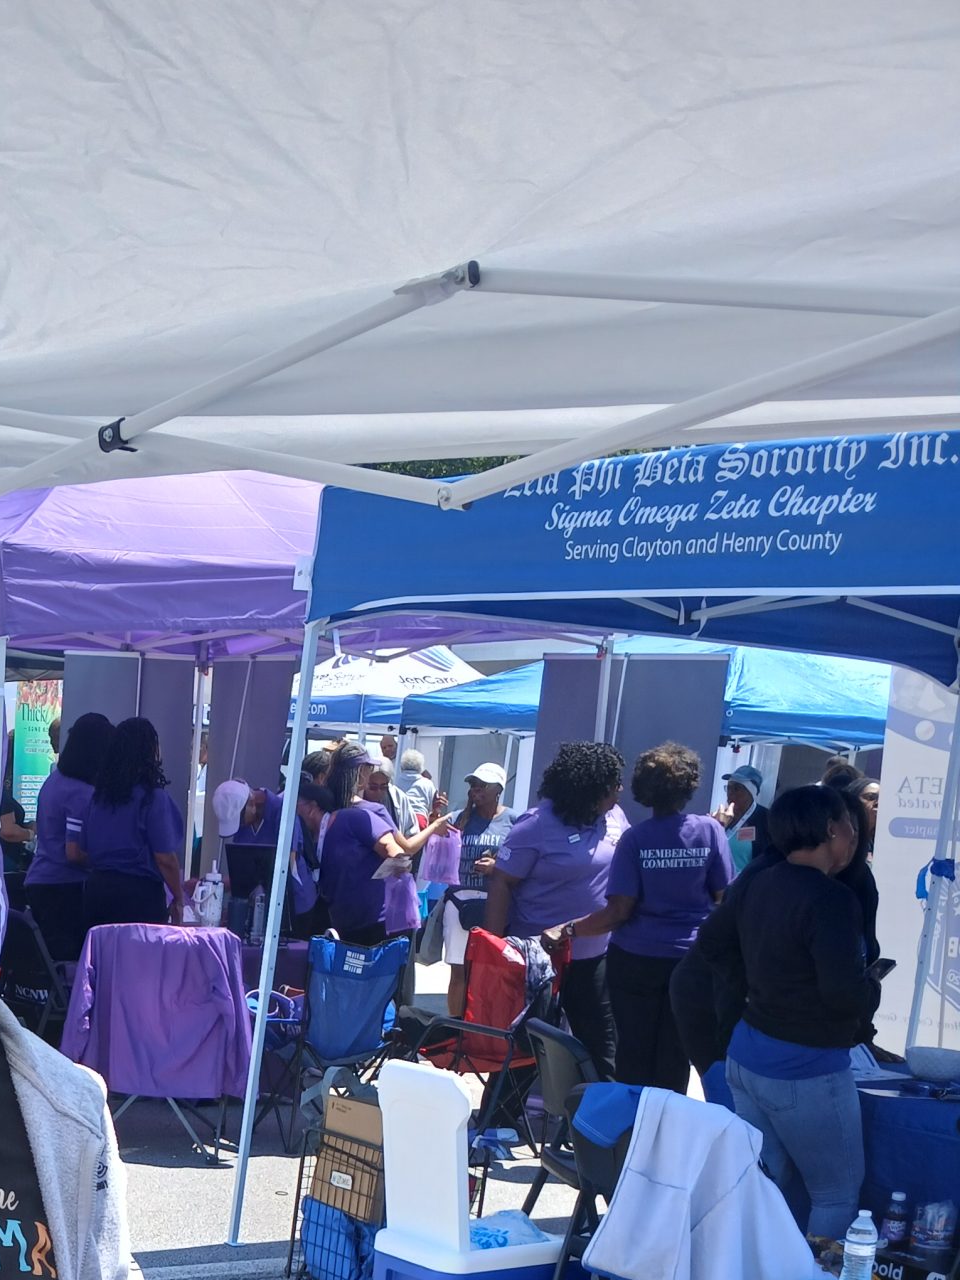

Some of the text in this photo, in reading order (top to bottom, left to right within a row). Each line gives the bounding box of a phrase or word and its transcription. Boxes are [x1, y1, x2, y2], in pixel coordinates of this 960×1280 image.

[632, 449, 708, 493] Beta
[715, 440, 869, 482] Sorority
[878, 431, 959, 470] Inc.
[544, 484, 878, 538] Sigma Omega Zeta Chapter
[565, 529, 843, 563] Serving Clayton and Henry County
[640, 847, 711, 859] MEMBERSHIP
[642, 857, 707, 870] COMMITTEE
